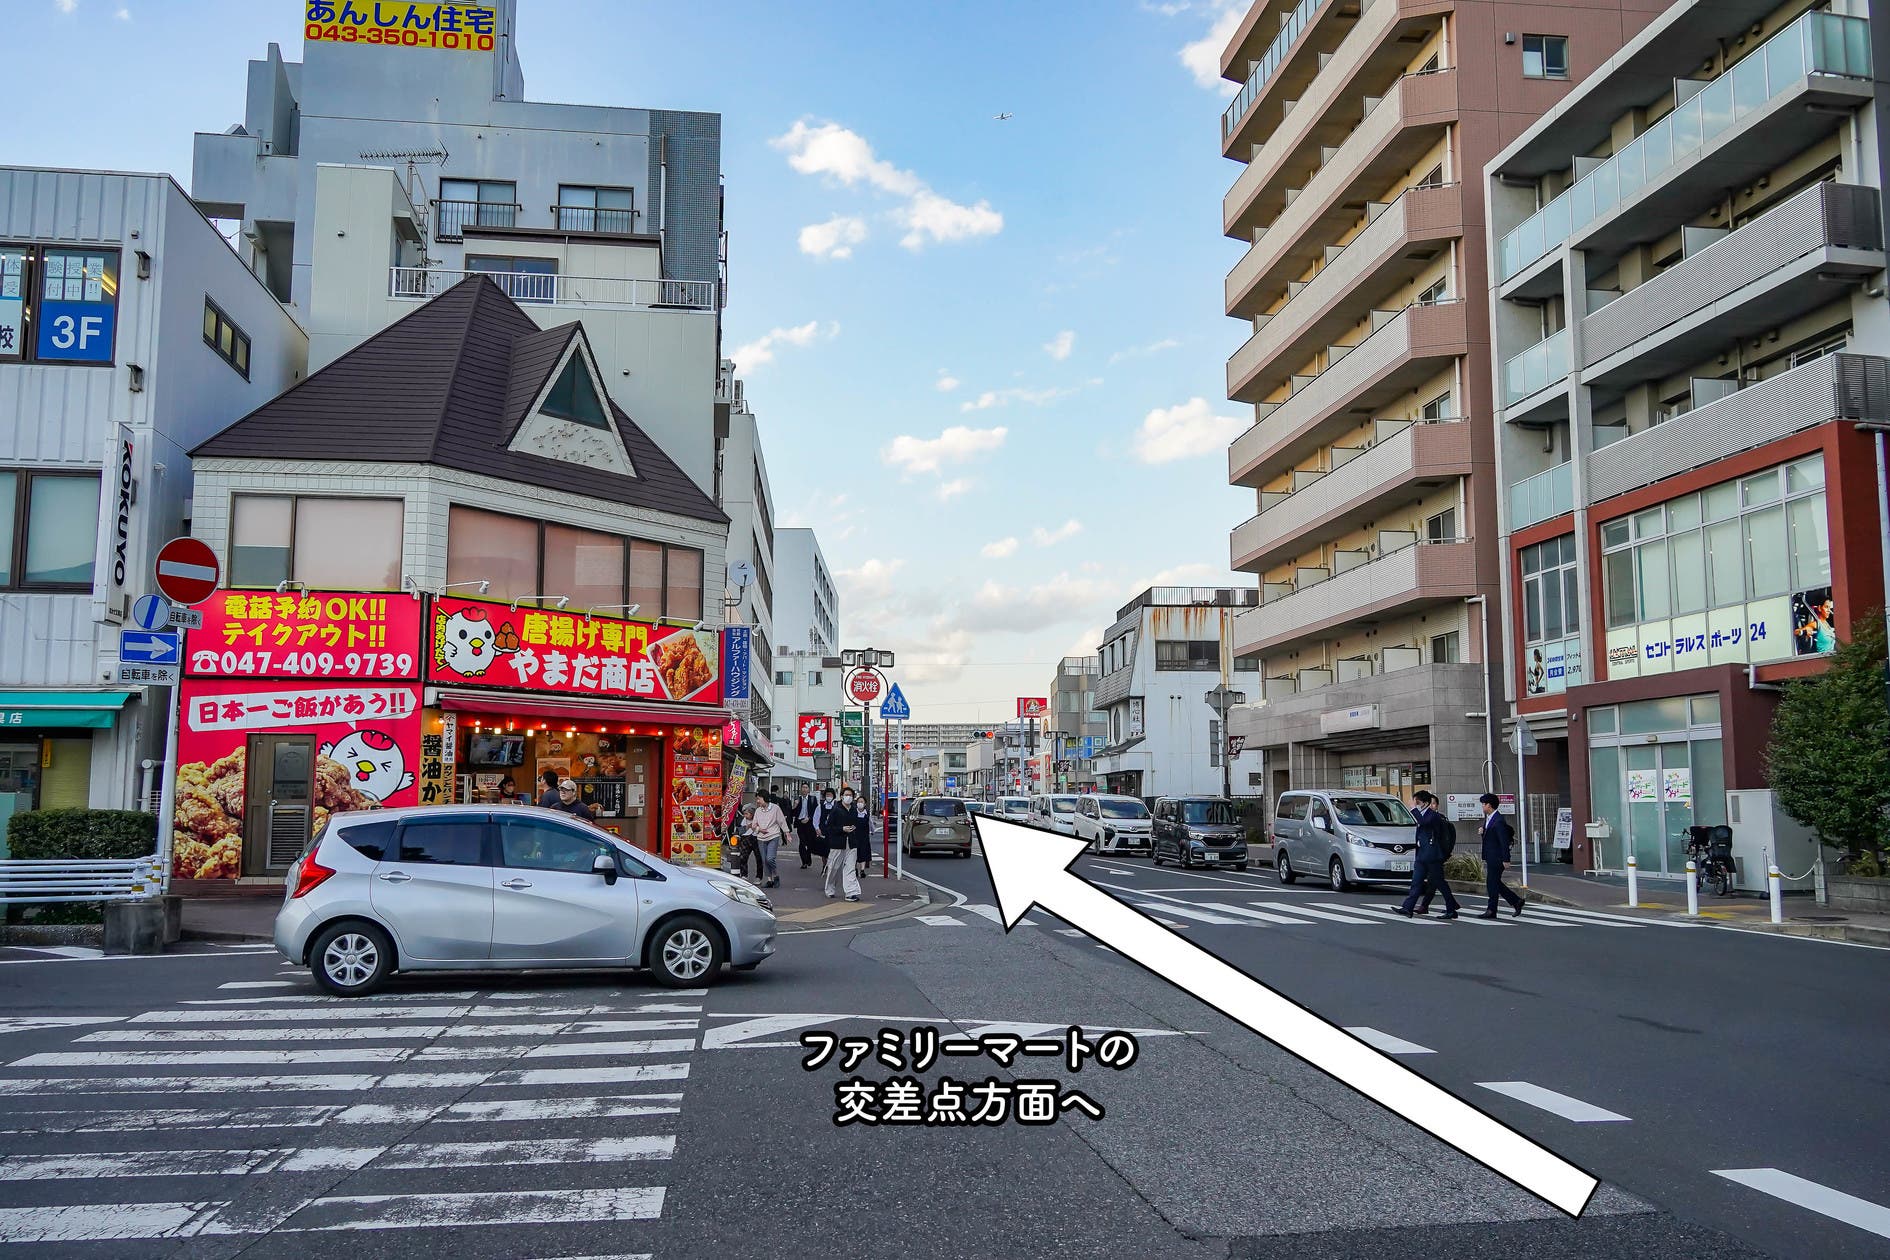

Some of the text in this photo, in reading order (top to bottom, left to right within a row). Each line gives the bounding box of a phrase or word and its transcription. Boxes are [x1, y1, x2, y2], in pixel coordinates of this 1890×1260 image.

[307, 0, 494, 34] あんしん住宅
[306, 24, 494, 51] 043-350-1010
[5, 281, 98, 297] 受付中!!
[52, 315, 102, 350] 3F
[115, 440, 133, 586] KOKUYO
[169, 611, 201, 626] 自転車を除く
[225, 594, 387, 621] 電話予約OK!!
[222, 622, 386, 648] テイクアウト!!
[521, 611, 648, 653] 唐揚げ専門
[1750, 622, 1767, 642] 24
[121, 668, 175, 681] 自転車を除く
[221, 650, 413, 677] 047-409-9739
[508, 648, 655, 694] やまだ商店
[731, 636, 741, 697] アルファーハウジング
[853, 680, 878, 692] 消火栓
[198, 692, 407, 724] 日本一ご飯があう!!
[421, 734, 442, 805] 醤油か
